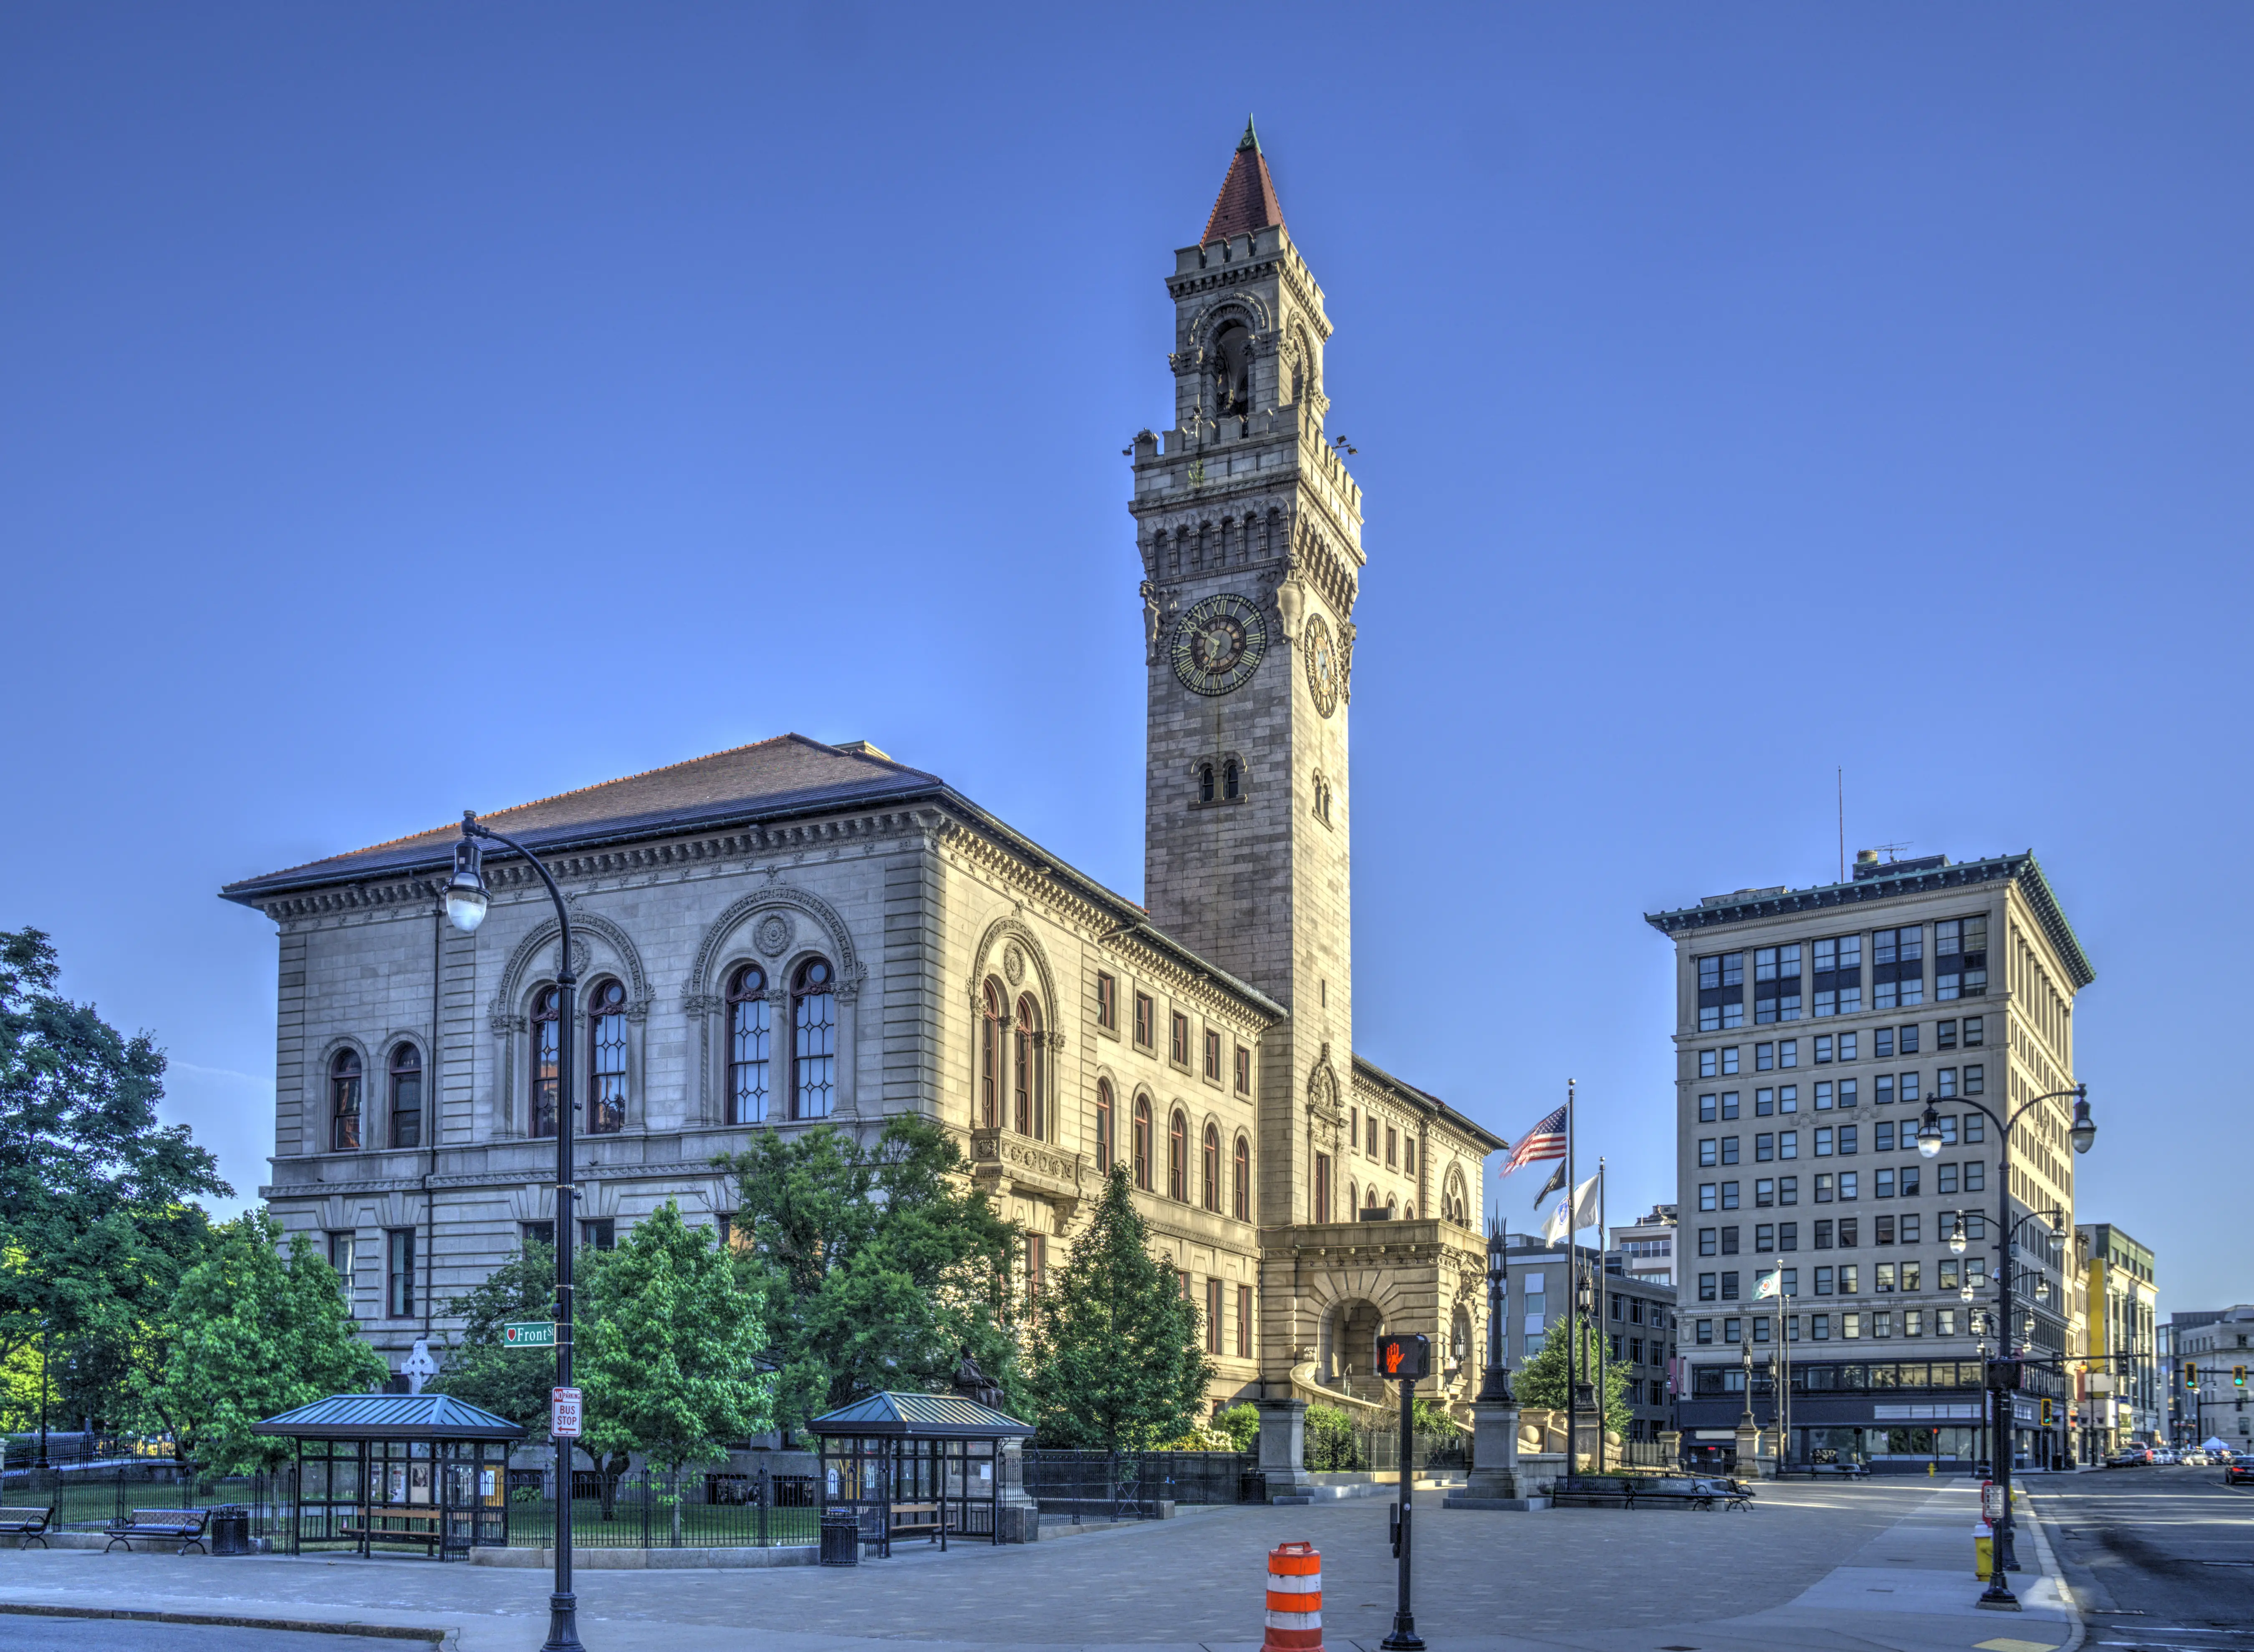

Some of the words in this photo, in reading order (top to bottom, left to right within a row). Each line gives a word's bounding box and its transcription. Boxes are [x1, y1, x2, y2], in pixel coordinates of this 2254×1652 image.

[1246, 632, 1260, 646] III
[517, 1328, 547, 1341] Front
[548, 1326, 554, 1336] St
[554, 1390, 563, 1400] NO
[560, 1405, 575, 1415] BUS
[557, 1416, 577, 1425] STOP
